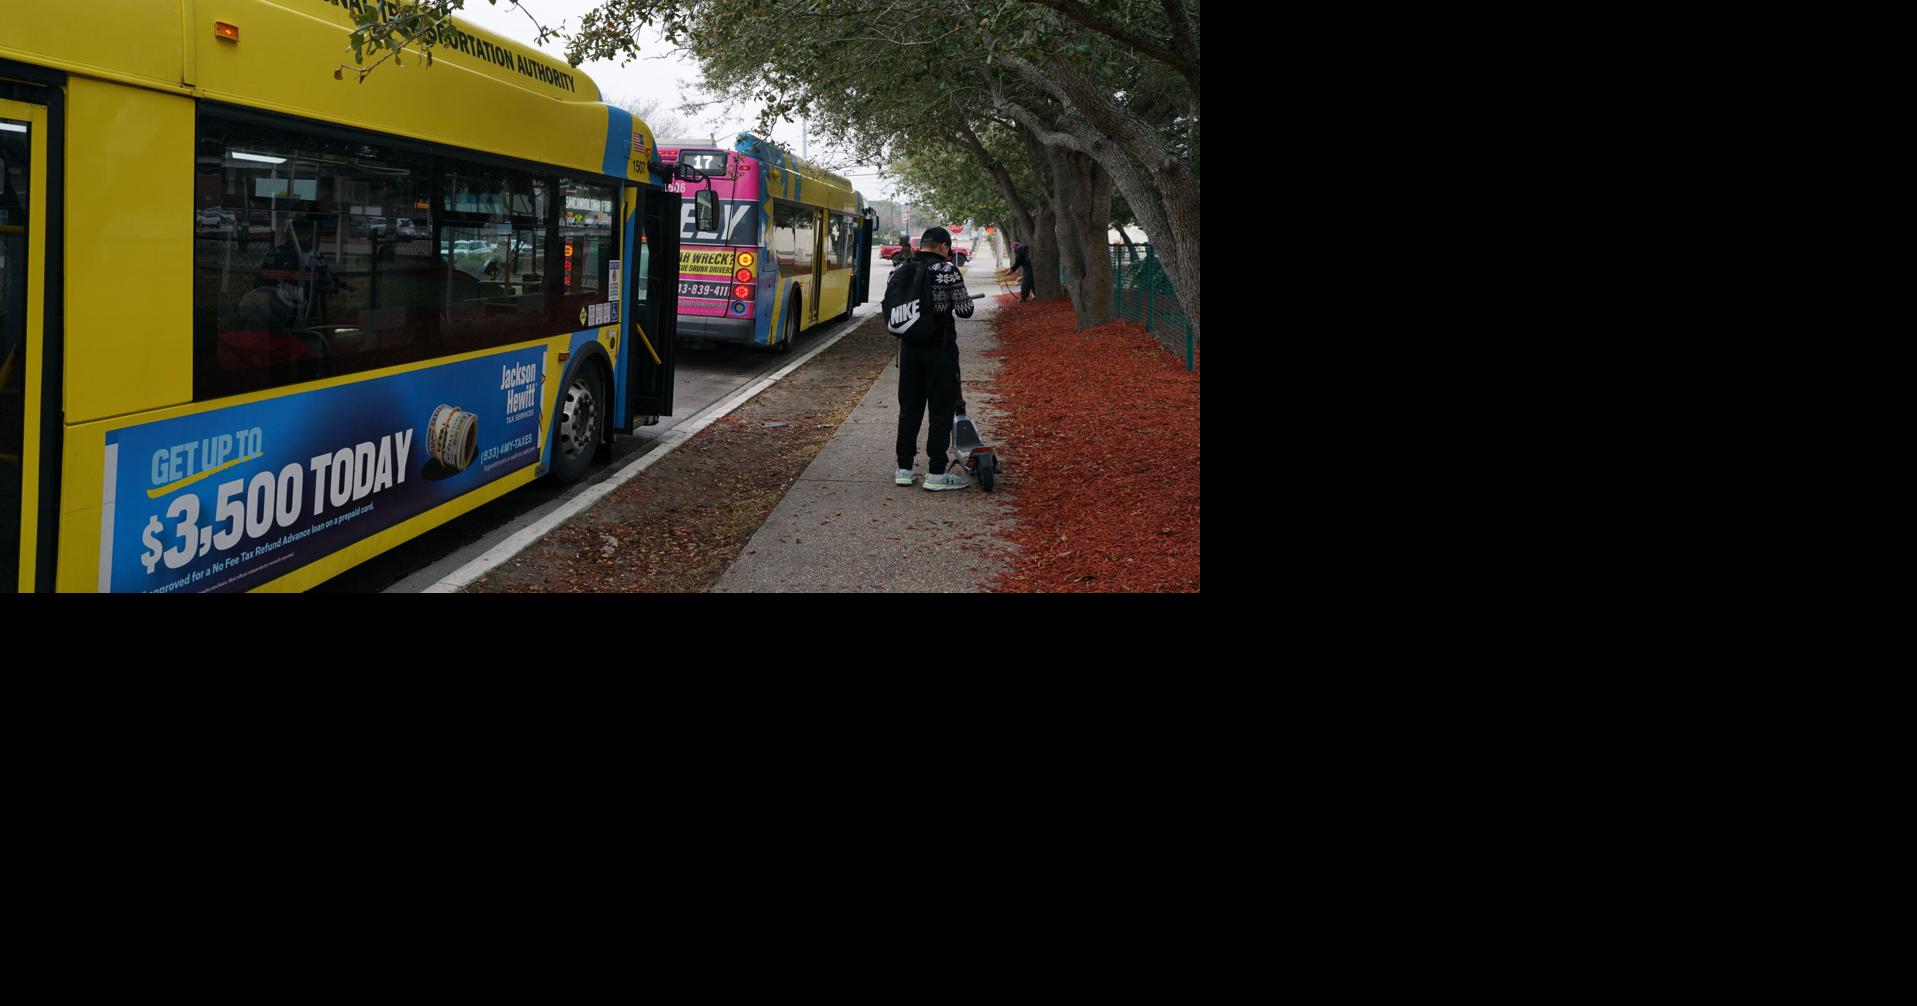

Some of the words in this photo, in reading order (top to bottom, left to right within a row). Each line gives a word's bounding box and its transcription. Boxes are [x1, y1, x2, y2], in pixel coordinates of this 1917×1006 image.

[377, 0, 515, 71] TRSPORTATION
[517, 54, 575, 93] AUTHORITY
[632, 160, 646, 175] 1507
[694, 155, 713, 169] 17
[689, 265, 709, 273] DRUNK
[692, 253, 734, 265] WRECK?
[890, 299, 920, 325] NIKE
[501, 362, 536, 390] Jackson
[506, 383, 535, 414] Hewitt
[506, 416, 514, 424] TAX
[515, 410, 534, 422] SERVICES
[151, 440, 198, 486] GET
[201, 434, 232, 472] UP
[236, 426, 262, 462] TO
[480, 446, 499, 464] (833)
[500, 433, 532, 455] 4MY-TAXES
[141, 462, 303, 574] $3,500
[310, 428, 413, 515] TODAY
[148, 573, 190, 593] proved
[192, 570, 204, 582] for
[212, 562, 224, 574] No
[225, 557, 239, 569] Fee
[241, 551, 254, 562] Tax
[255, 537, 282, 557] Refund
[282, 528, 311, 546] Advance
[311, 522, 325, 533] loan
[326, 519, 333, 527] on
[338, 505, 360, 525] prepaid
